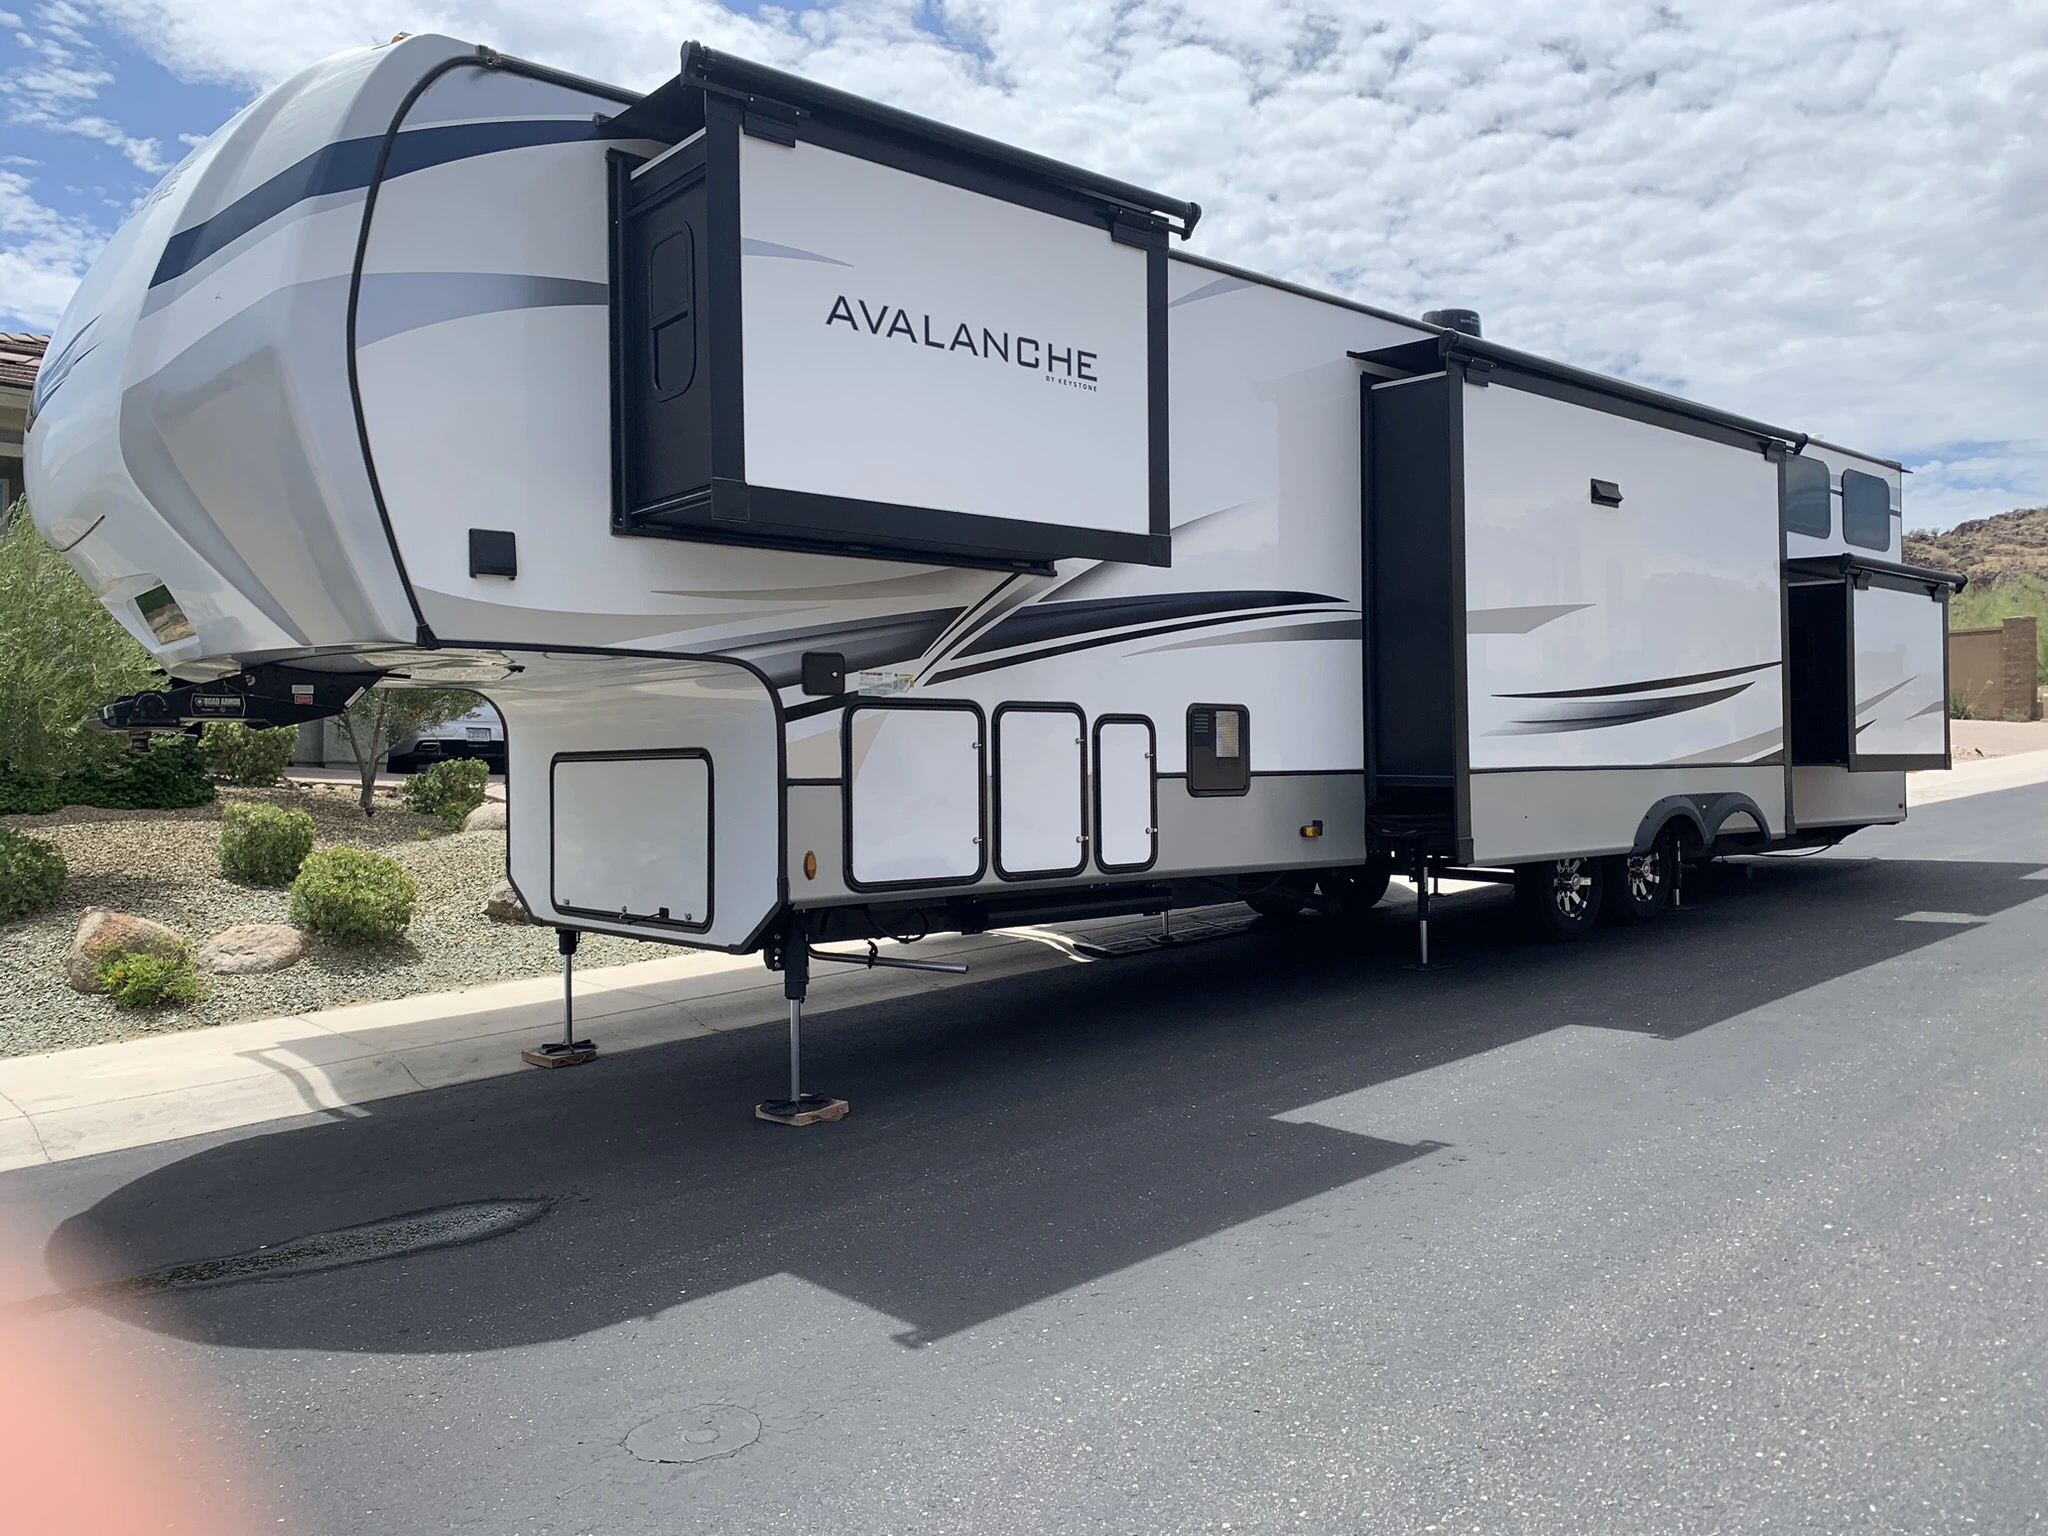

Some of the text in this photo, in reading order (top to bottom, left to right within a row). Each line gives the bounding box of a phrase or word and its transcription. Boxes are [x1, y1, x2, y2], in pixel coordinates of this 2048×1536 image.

[825, 295, 1098, 382] AVALANCHE
[1058, 378, 1097, 392] KEYSTONE
[204, 697, 241, 706] ROAD ARMOR
